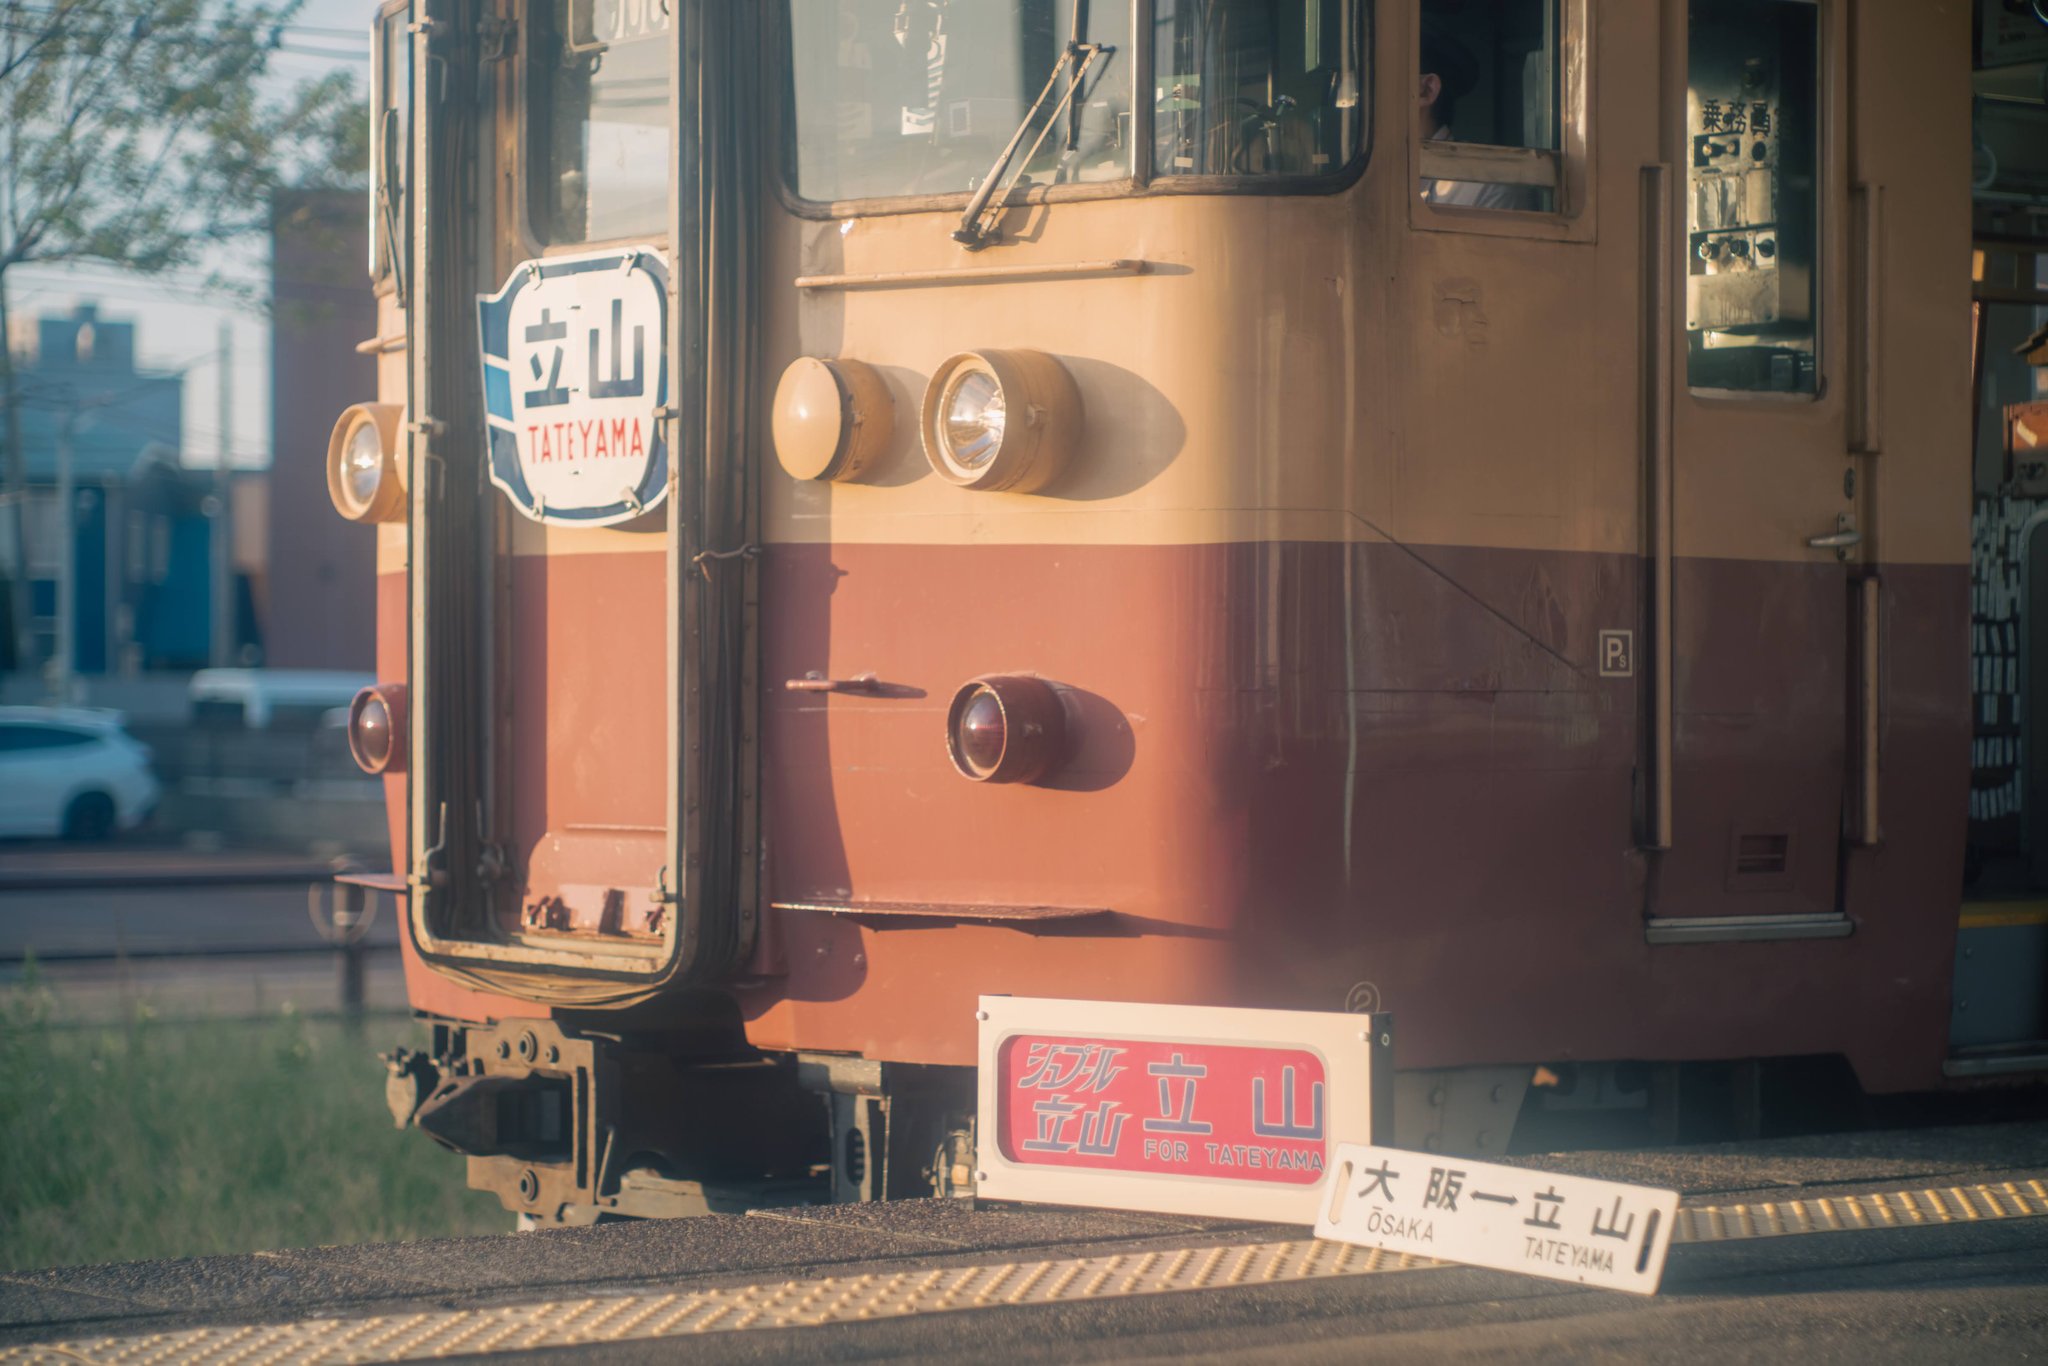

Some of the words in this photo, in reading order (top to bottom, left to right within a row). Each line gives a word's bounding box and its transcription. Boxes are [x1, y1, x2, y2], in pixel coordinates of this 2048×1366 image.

[525, 298, 644, 408] 立山
[528, 417, 643, 463] TATEYAMA
[1018, 1043, 1129, 1093] シュプール
[1143, 1053, 1324, 1140] 立山
[1022, 1094, 1133, 1157] 立山
[1144, 1138, 1189, 1162] FOR
[1205, 1143, 1324, 1172] TATEYAMA
[1358, 1160, 1467, 1212] 大阪
[1523, 1185, 1635, 1242] 立山
[1524, 1236, 1614, 1273] TATEYAMA
